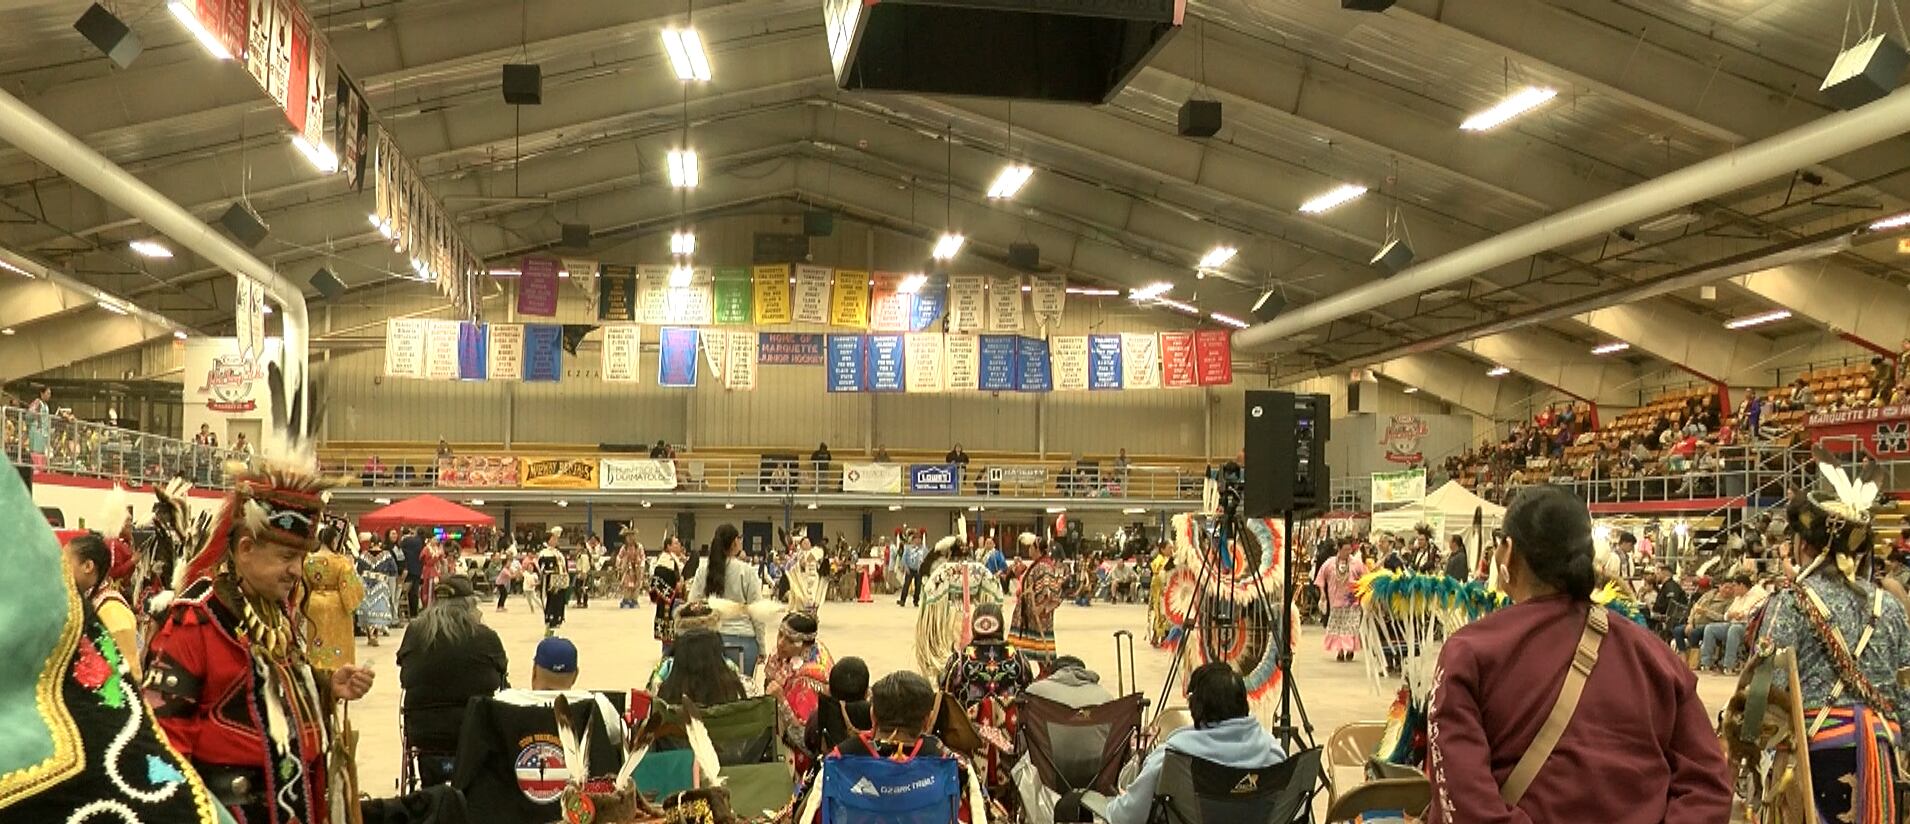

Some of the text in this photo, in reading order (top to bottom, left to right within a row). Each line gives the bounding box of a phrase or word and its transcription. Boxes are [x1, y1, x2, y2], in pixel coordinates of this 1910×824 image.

[761, 344, 818, 353] MARQUETTE
[759, 354, 824, 363] JUNIOR HOCKEY
[1809, 410, 1864, 425] MARQUETTE
[1867, 408, 1878, 419] IS
